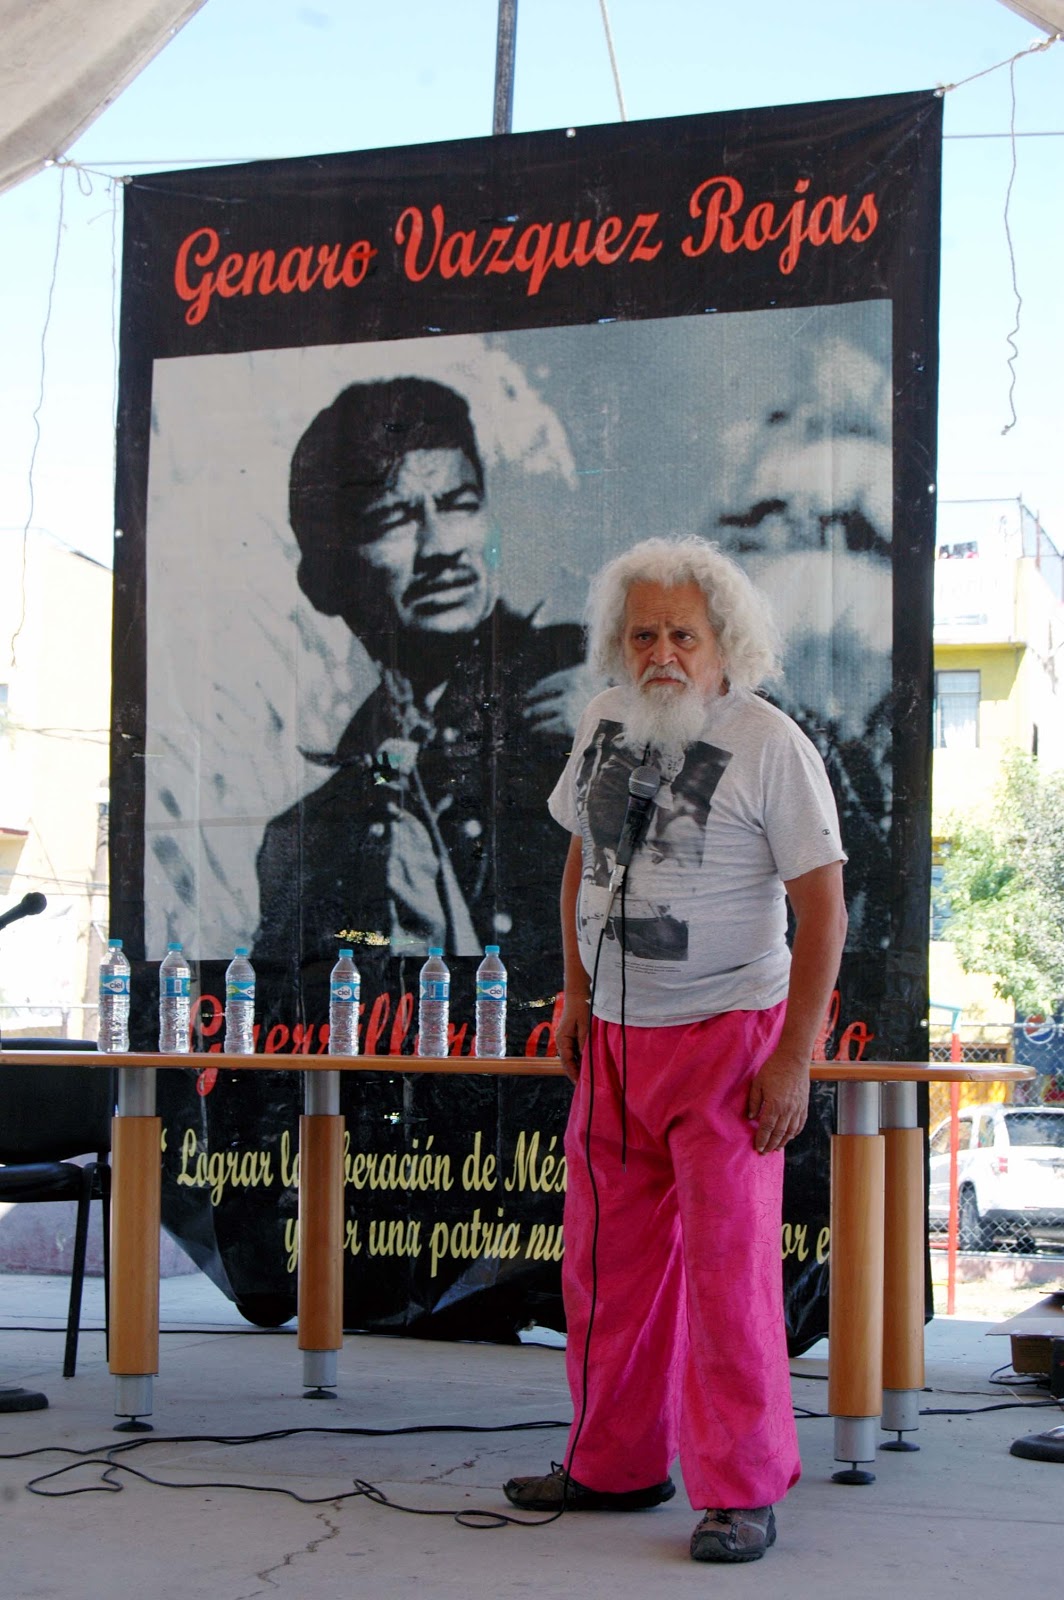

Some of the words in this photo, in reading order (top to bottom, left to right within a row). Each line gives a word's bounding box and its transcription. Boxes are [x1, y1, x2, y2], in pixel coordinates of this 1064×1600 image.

[174, 227, 377, 325] Genaro
[394, 204, 663, 295] Vazquez
[681, 175, 878, 274] Rojas
[177, 1129, 274, 1206] Lograr
[462, 1130, 498, 1191] de
[369, 1219, 421, 1257] una
[429, 1207, 521, 1278] patria
